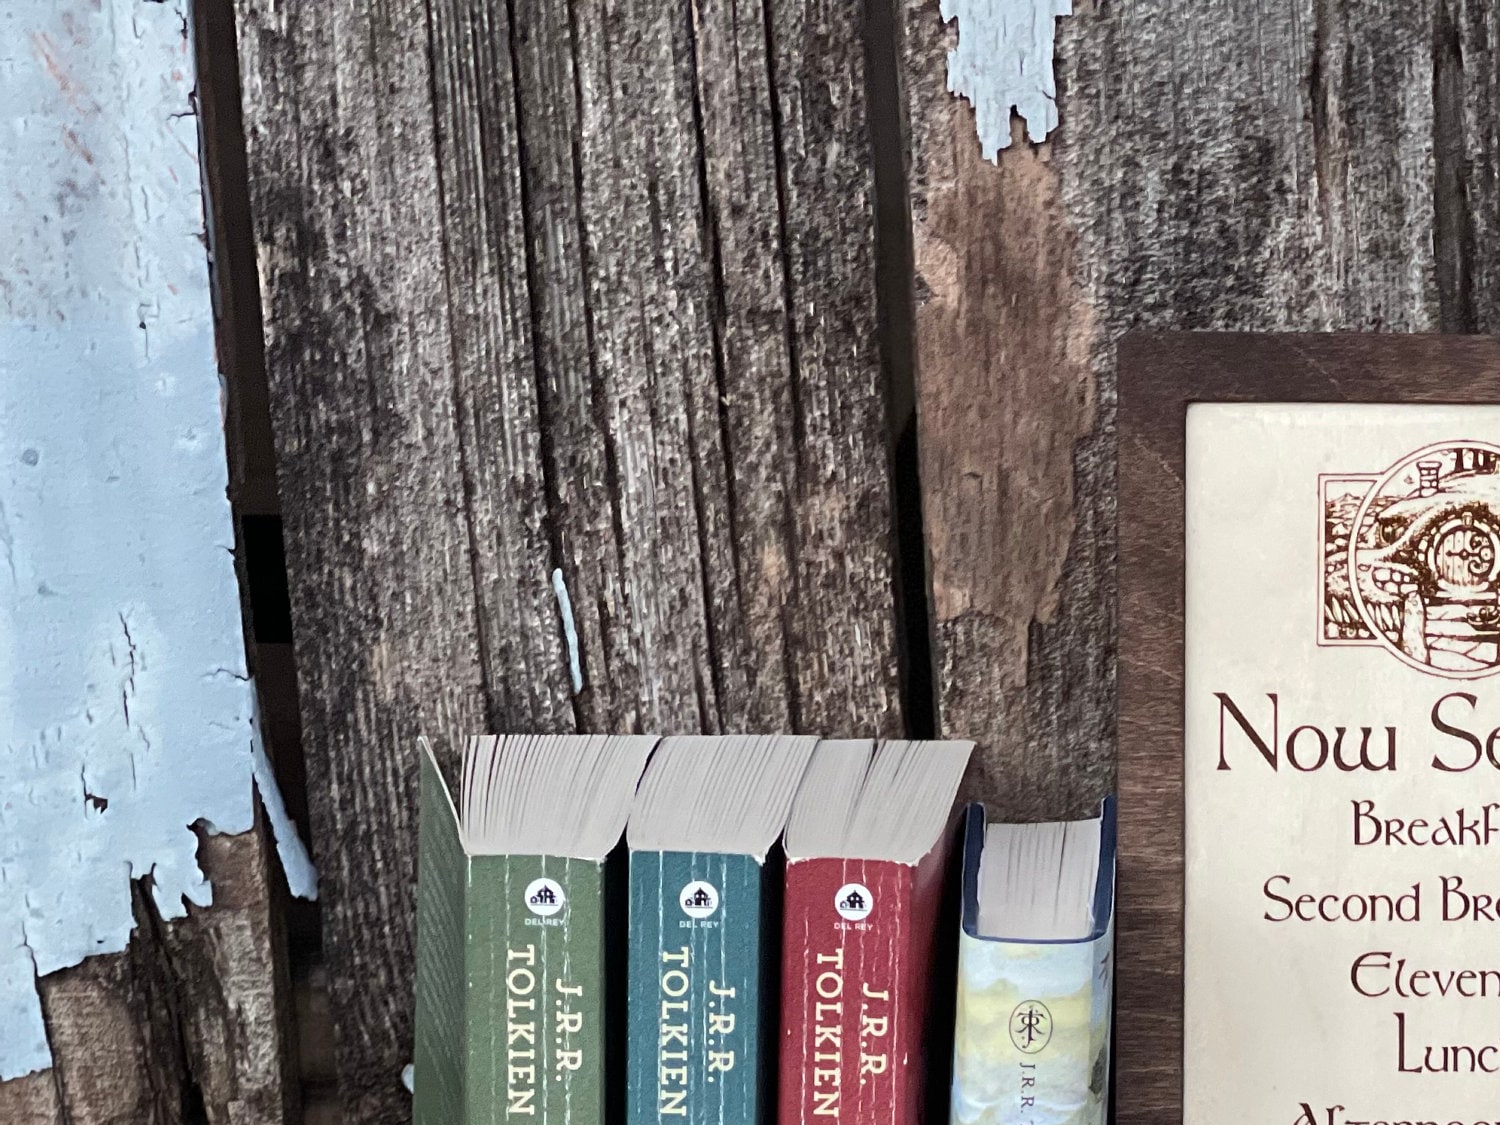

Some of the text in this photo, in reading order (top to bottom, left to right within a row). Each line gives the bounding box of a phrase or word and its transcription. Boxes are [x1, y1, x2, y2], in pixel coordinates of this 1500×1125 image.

[1213, 692, 1398, 773] Now
[679, 920, 719, 928] DEL REY
[834, 922, 874, 931] DEL REY
[1262, 874, 1421, 923] Second
[507, 943, 536, 1116] TOLKIEN
[555, 978, 583, 1082] J.R.R.
[659, 946, 689, 1117] TOLKIEN
[707, 979, 736, 1083] J.R.R.
[813, 947, 844, 1118] TOLKIEN
[859, 982, 889, 1086] J.R.R.
[1019, 1062, 1036, 1114] J.R.R.
